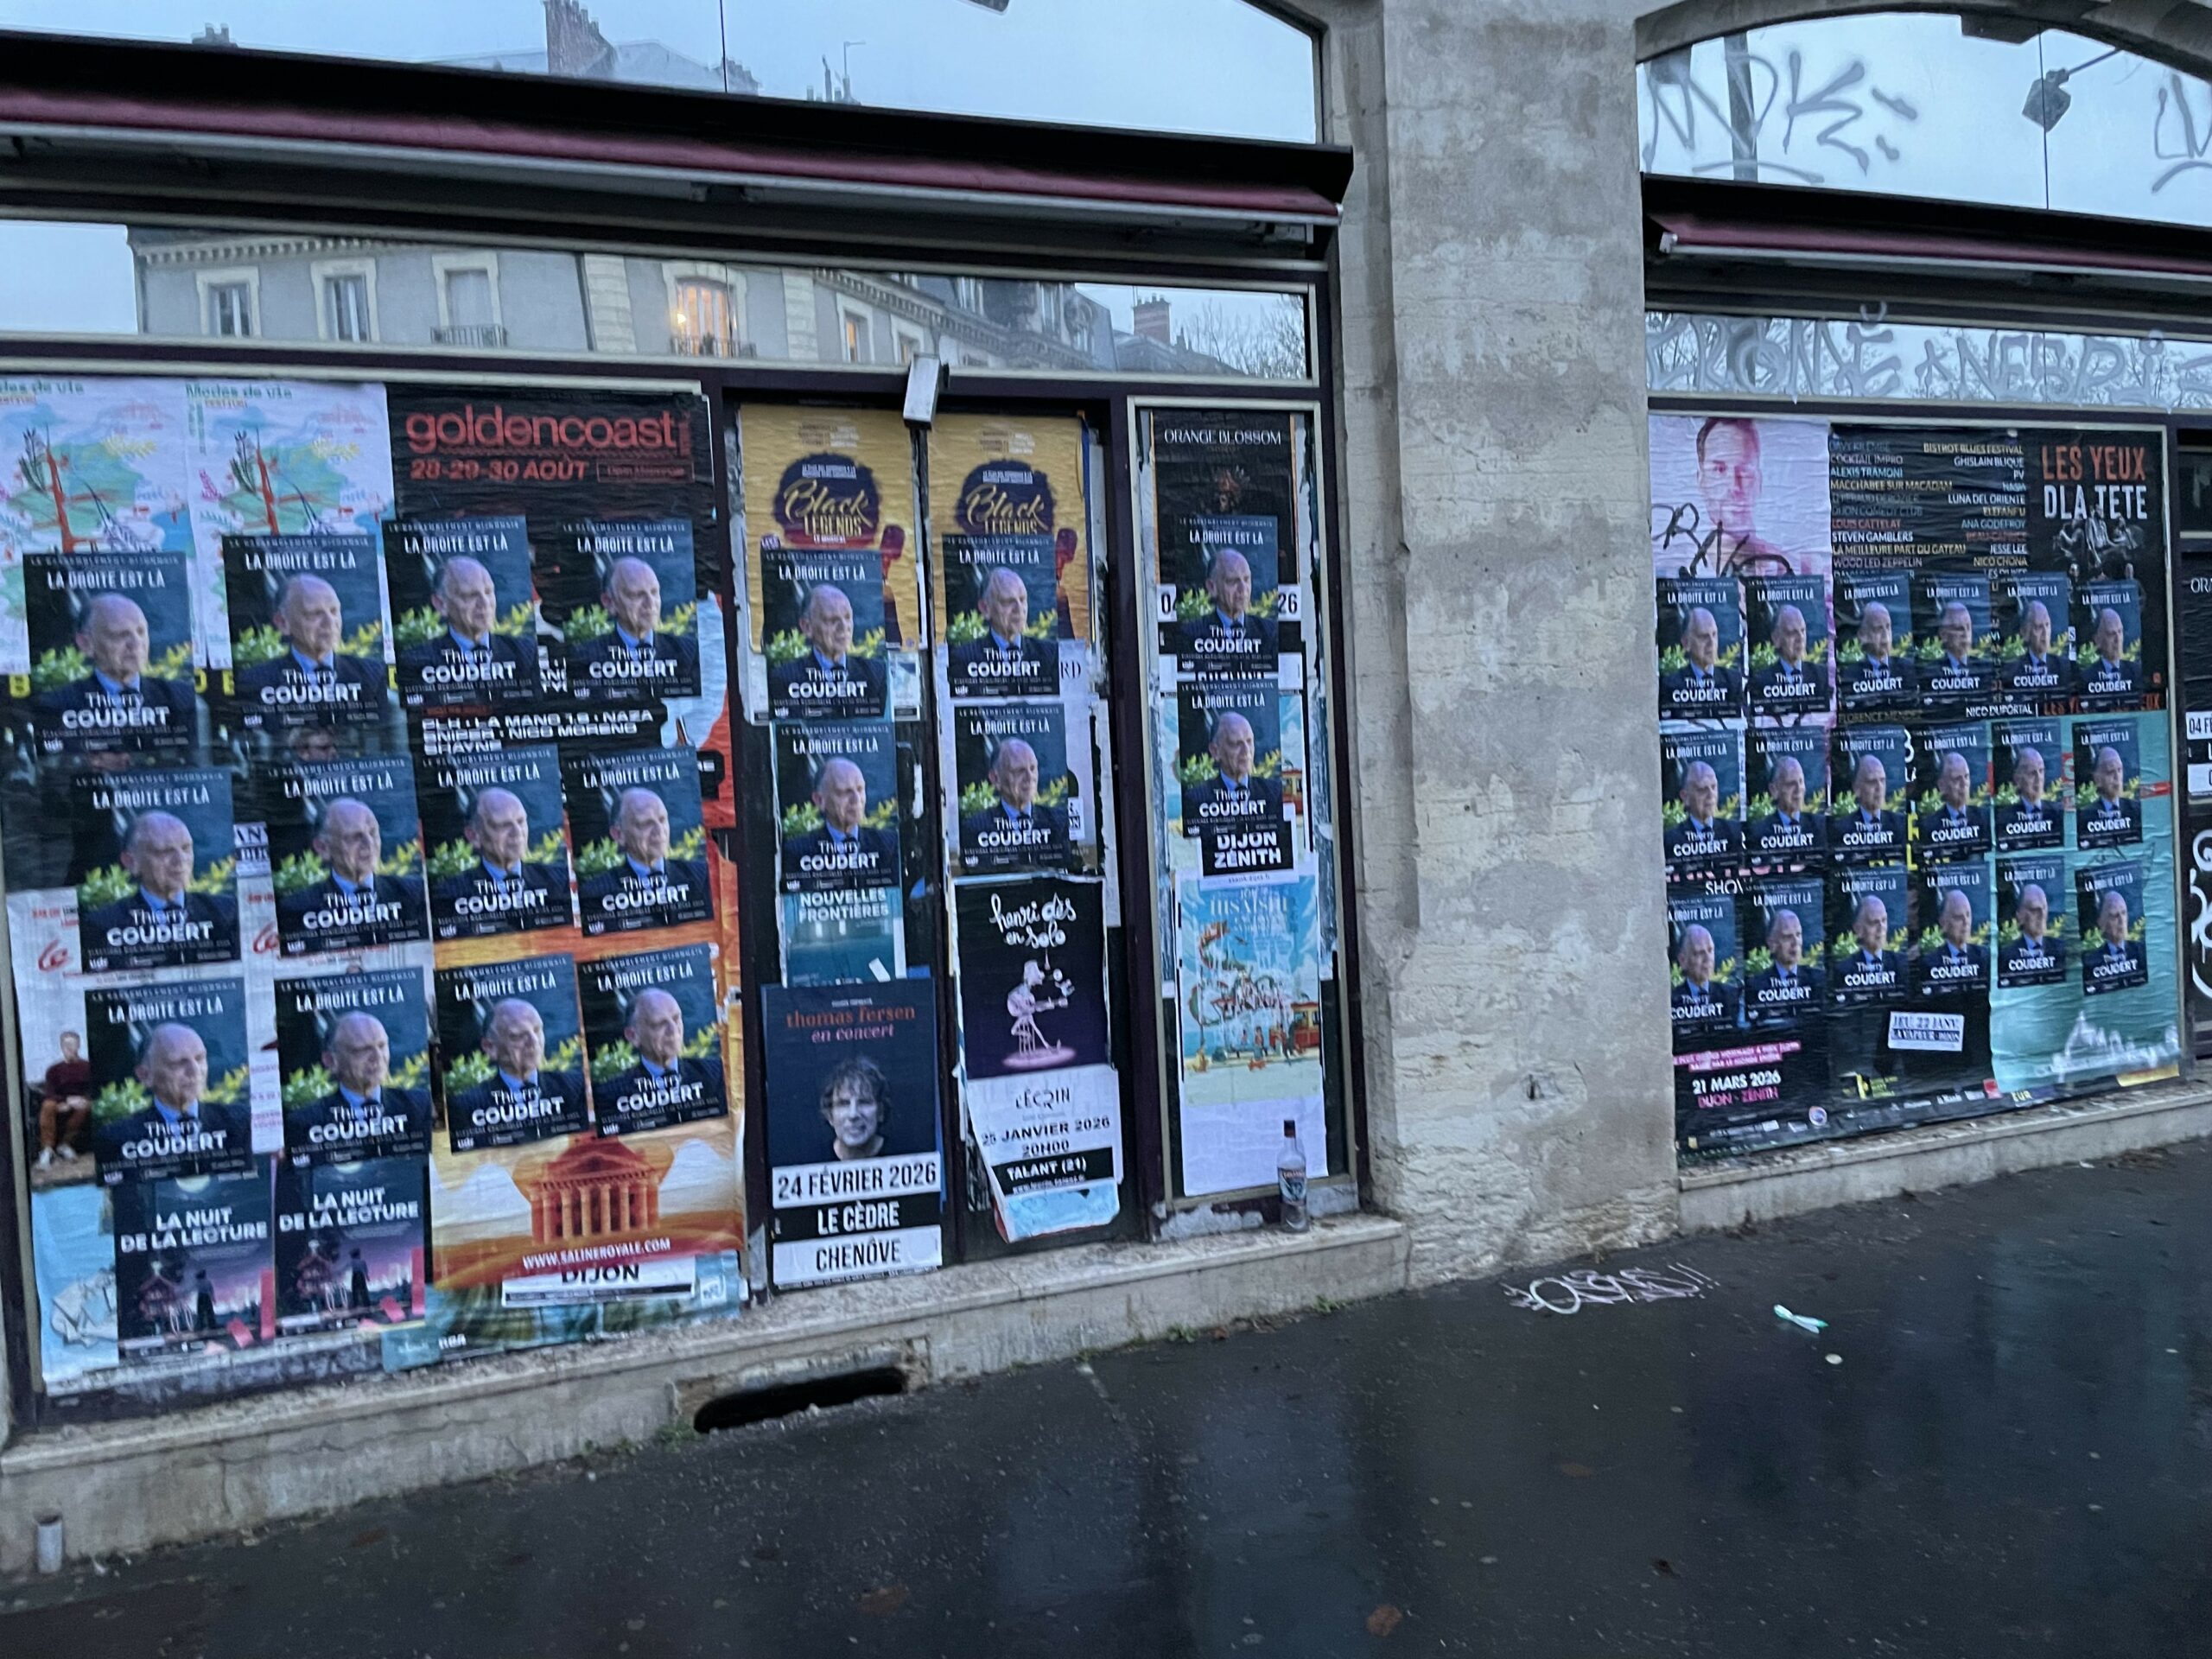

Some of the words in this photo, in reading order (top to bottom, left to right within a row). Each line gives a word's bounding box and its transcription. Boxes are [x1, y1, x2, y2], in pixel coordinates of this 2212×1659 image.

[405, 404, 677, 454] goldencoast
[1164, 429, 1217, 445] ORANGE
[1218, 429, 1281, 445] BLOSSOM
[1830, 467, 1859, 478] ALEXIS
[1862, 467, 1904, 478] TRAMONI
[2042, 446, 2082, 481] LES
[2089, 447, 2145, 480] YEUX
[1887, 480, 1904, 491] SUR
[1905, 480, 1953, 492] MACADAM
[784, 479, 874, 528] Black
[966, 484, 1049, 531] Black
[1948, 493, 1971, 505] LUNA
[2044, 484, 2087, 520] DLA
[2094, 485, 2148, 520] TETE
[1961, 519, 1980, 529] ANA
[577, 537, 592, 553] LA
[637, 537, 656, 553] EST
[658, 534, 674, 553] LÀ
[1832, 531, 1866, 543] STEVEN
[1866, 531, 1913, 543] GAMBLERS
[1833, 544, 1844, 556] LA
[1846, 543, 1893, 555] MEILLEURE
[1894, 543, 1916, 555] PART
[1932, 543, 1966, 555] GATEAU
[1990, 543, 2012, 555] JESSE
[1974, 556, 1996, 567] NICO
[1997, 556, 2028, 567] CHONA
[1194, 639, 1262, 653] COUDERT
[422, 660, 517, 684] COUDERT
[589, 659, 678, 679] COUDERT
[968, 661, 1040, 678] COUDERT
[788, 681, 867, 699] COUDERT
[1764, 683, 1815, 698] COUDERT
[1853, 678, 1903, 693] COUDERT
[1931, 677, 1980, 690] COUDERT
[2014, 675, 2060, 688] COUDERT
[2088, 680, 2132, 693] COUDERT
[261, 683, 361, 705] COUDERT
[1673, 689, 1727, 702] COUDERT
[62, 706, 170, 729] COUDERT
[1199, 800, 1266, 817] COUDERT
[2088, 817, 2131, 832] COUDERT
[978, 829, 1051, 848] COUDERT
[1217, 831, 1278, 850] DIJON
[1761, 833, 1814, 849] COUDERT
[799, 853, 879, 871] COUDERT
[1214, 849, 1281, 868] ZÉNITH
[455, 889, 549, 915] COUDERT
[602, 884, 690, 912] COUDERT
[799, 887, 887, 908] NOUVELLES
[303, 902, 402, 930] COUDERT
[798, 902, 889, 924] FRONTIÈRES
[107, 921, 213, 947] COUDERT
[2008, 957, 2056, 971] COUDERT
[1845, 972, 1896, 987] COUDERT
[787, 1009, 854, 1028] thomas
[859, 1005, 916, 1023] fersen
[810, 1028, 831, 1044] en
[836, 1023, 894, 1041] concert
[1692, 1079, 1707, 1095] 21
[1711, 1073, 1748, 1092] MARS
[1750, 1069, 1782, 1087] 2026
[617, 1083, 704, 1114] COUDERT
[473, 1096, 564, 1127] COUDERT
[1001, 1122, 1069, 1142] JANVIER
[1075, 1116, 1110, 1132] 2026
[1007, 1160, 1058, 1181] TALANT
[778, 1175, 802, 1201] 24
[809, 1166, 883, 1196] FÉVRIER
[889, 1162, 937, 1187] 2026
[314, 1192, 338, 1211] LA
[341, 1187, 385, 1207] NUIT
[156, 1212, 182, 1231] LA
[186, 1206, 233, 1228] NUIT
[279, 1214, 305, 1232] DE
[308, 1211, 334, 1229] LA
[337, 1201, 419, 1226] LECTURE
[818, 1208, 838, 1236] LE
[842, 1201, 899, 1231] CÈDRE
[121, 1233, 148, 1253] DE
[150, 1230, 178, 1250] LA
[181, 1221, 268, 1247] LECTURE
[523, 1237, 671, 1269] WWW.SALINEROYALE.COM
[816, 1238, 901, 1273] CHENÔVE
[562, 1263, 639, 1284] DIJON
